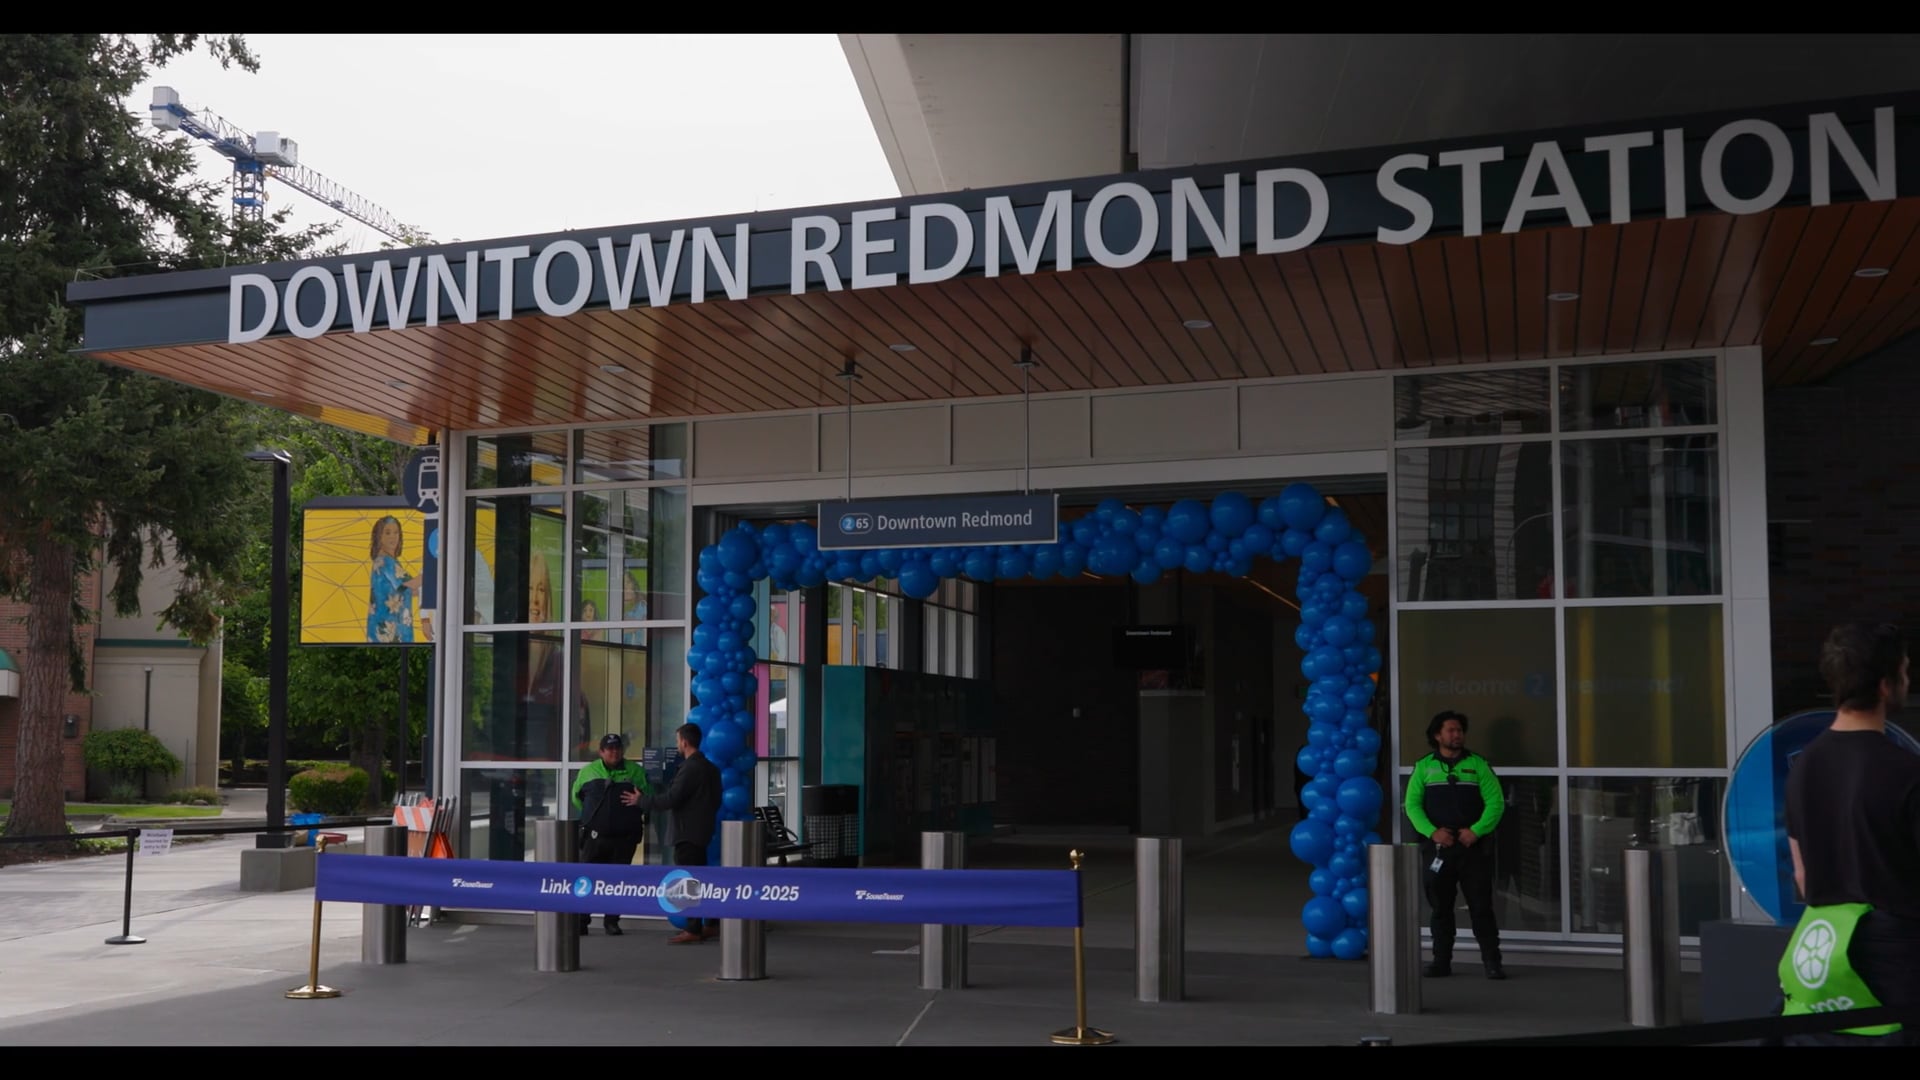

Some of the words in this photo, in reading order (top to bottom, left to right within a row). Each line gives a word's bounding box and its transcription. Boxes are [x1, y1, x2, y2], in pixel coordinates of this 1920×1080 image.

[228, 223, 749, 344] DOWNTOWN
[790, 168, 1330, 295] REDMOND
[1376, 106, 1896, 245] STATION
[855, 518, 869, 529] 65
[878, 515, 956, 531] Downtown
[962, 508, 1032, 527] Redmond
[1417, 674, 1518, 695] welcome
[1532, 673, 1545, 695] 2
[541, 878, 571, 894] Link
[577, 879, 588, 895] 2
[594, 880, 665, 898] Redmond
[699, 883, 730, 902] May
[760, 885, 799, 902] 2025
